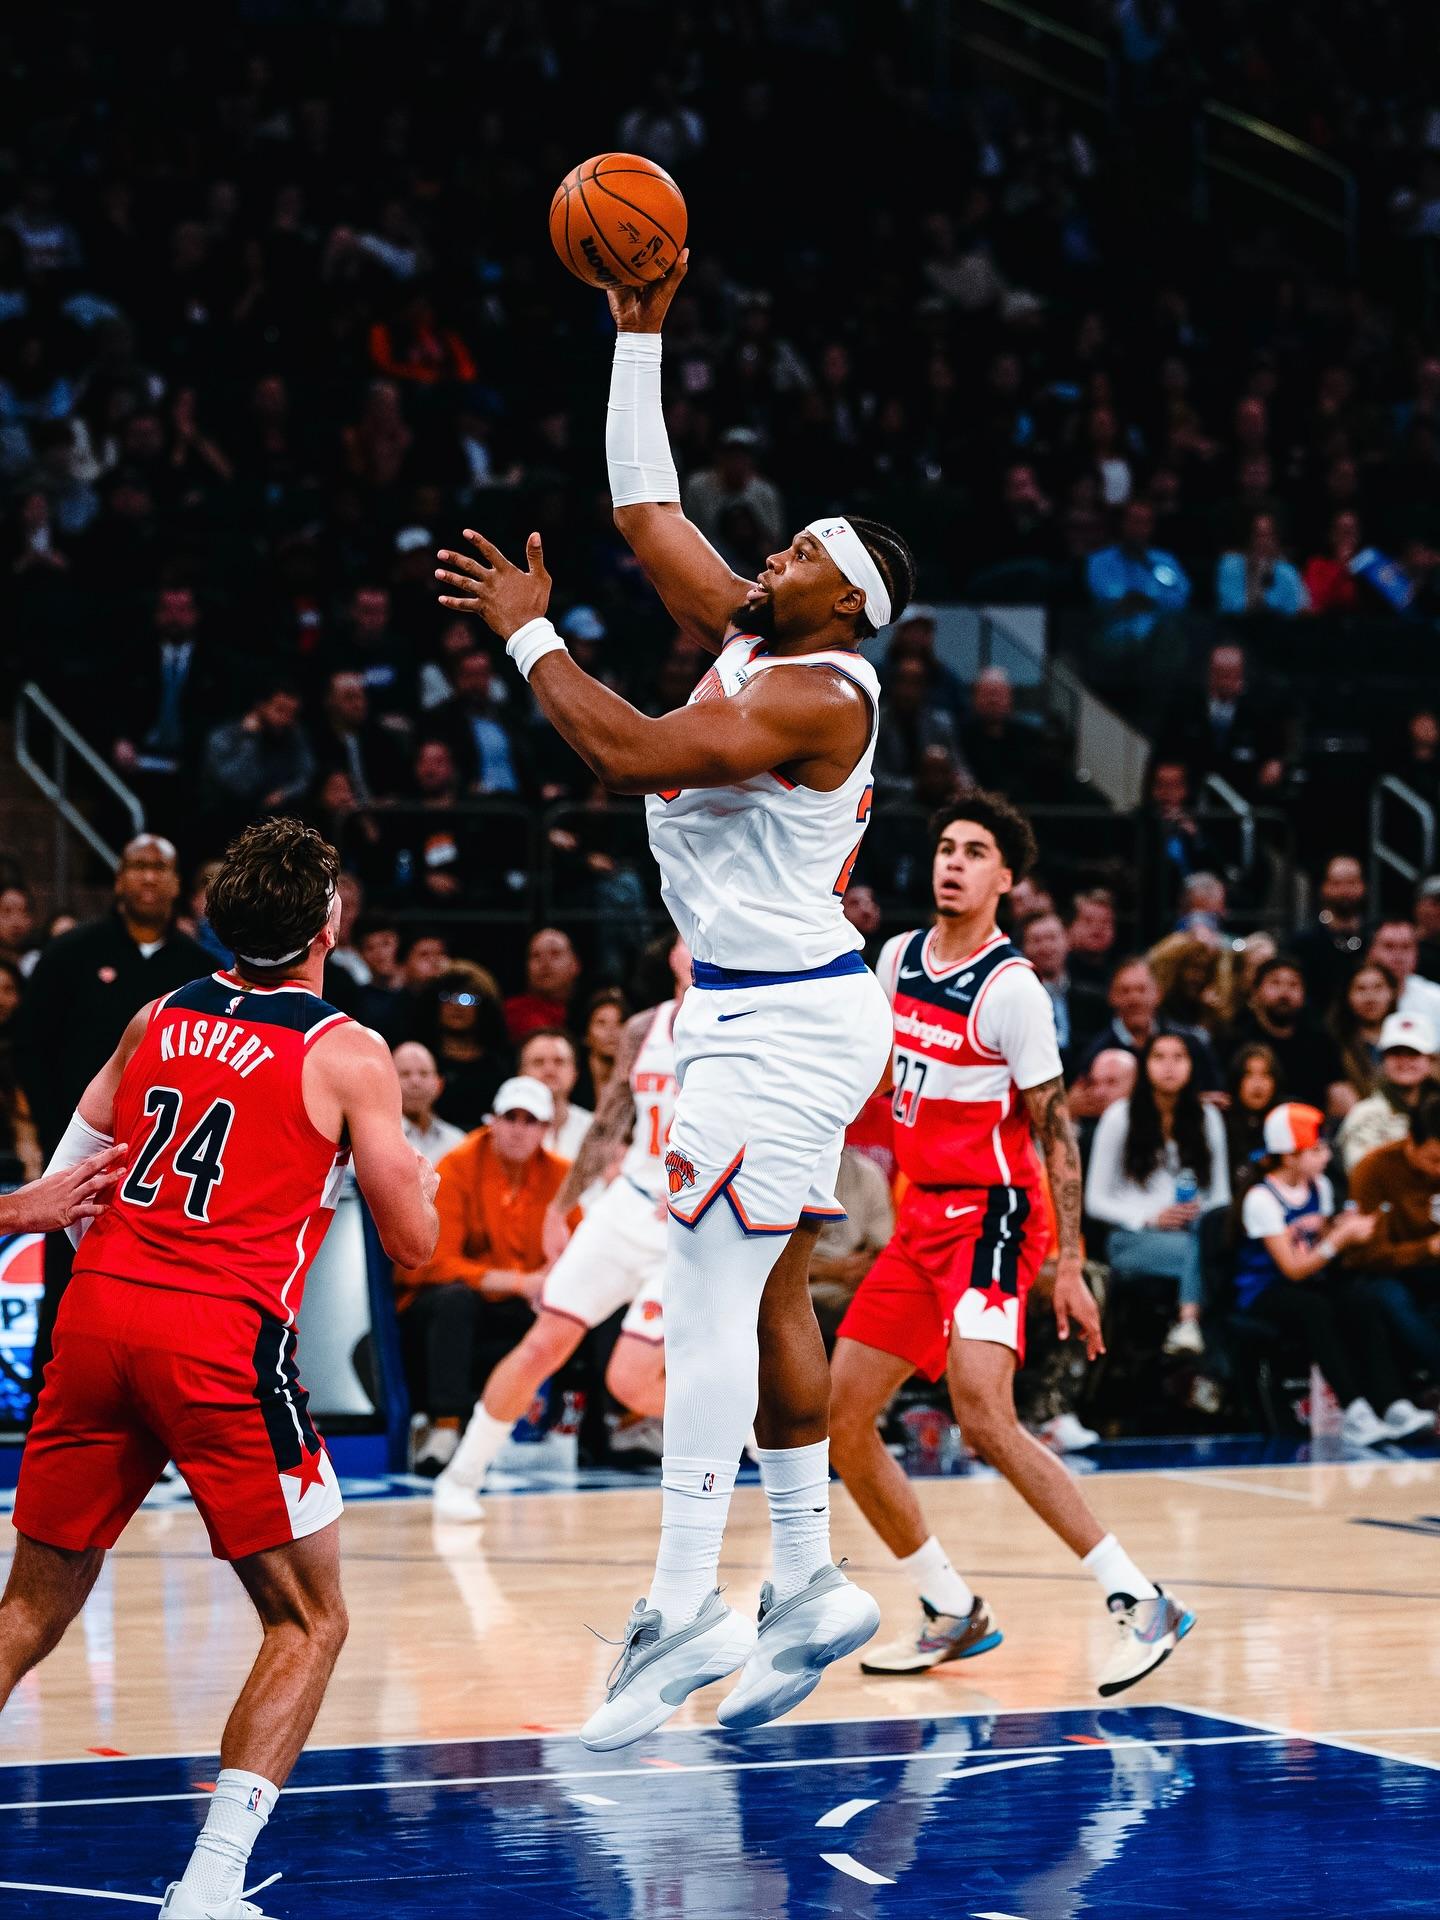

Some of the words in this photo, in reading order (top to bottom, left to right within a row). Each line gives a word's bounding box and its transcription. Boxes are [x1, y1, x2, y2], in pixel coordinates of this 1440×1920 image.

[161, 1020, 275, 1079] KISPERT
[893, 1010, 964, 1051] ashington
[892, 1054, 928, 1128] 27
[120, 1085, 236, 1223] 24
